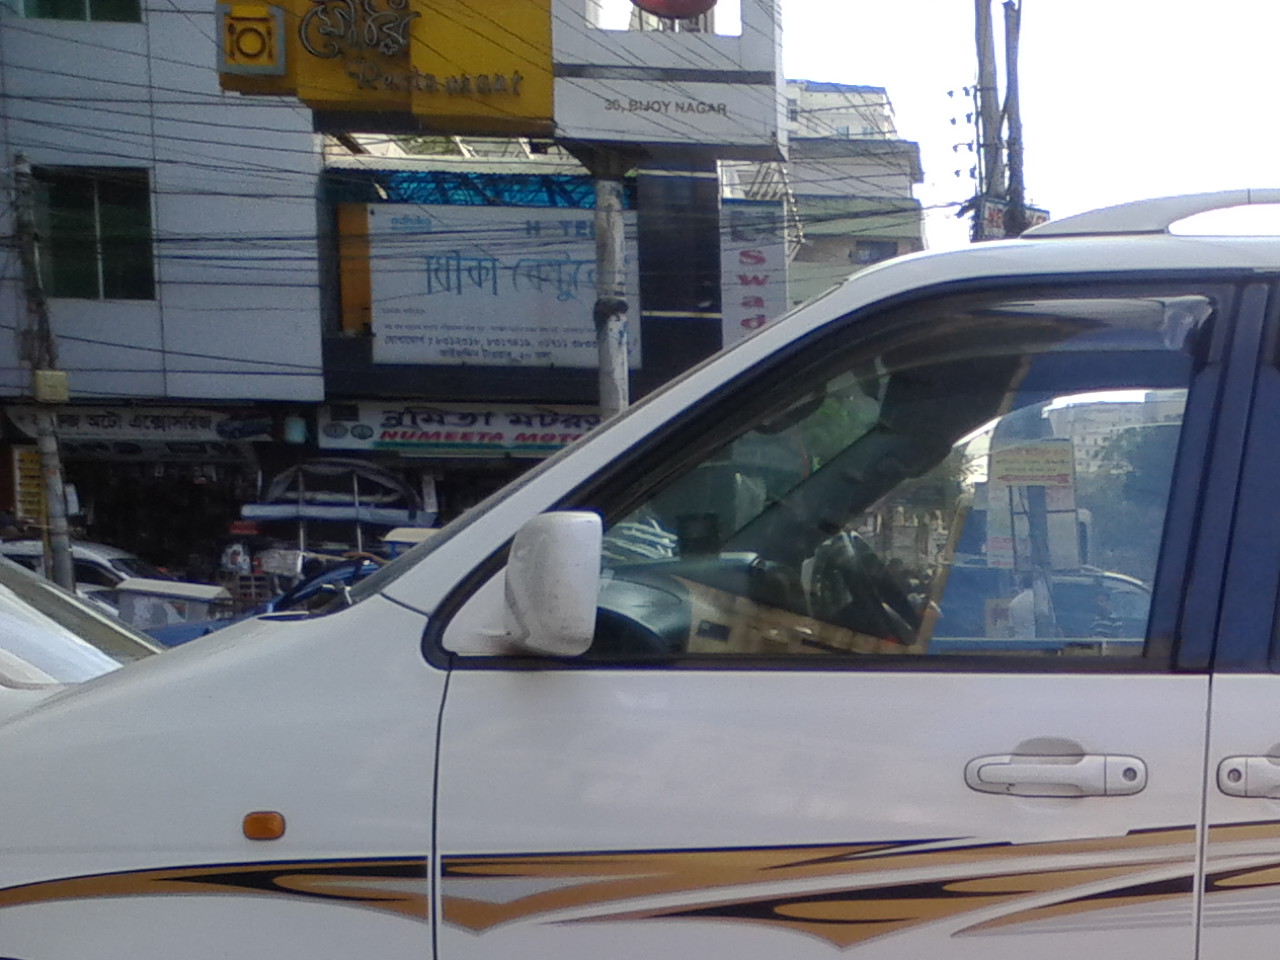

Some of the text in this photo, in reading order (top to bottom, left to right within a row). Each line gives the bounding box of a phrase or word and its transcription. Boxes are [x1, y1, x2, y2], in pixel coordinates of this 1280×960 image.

[629, 99, 673, 113] BIJOY
[675, 101, 727, 116] NAGAR
[380, 430, 505, 441] NUMEETA
